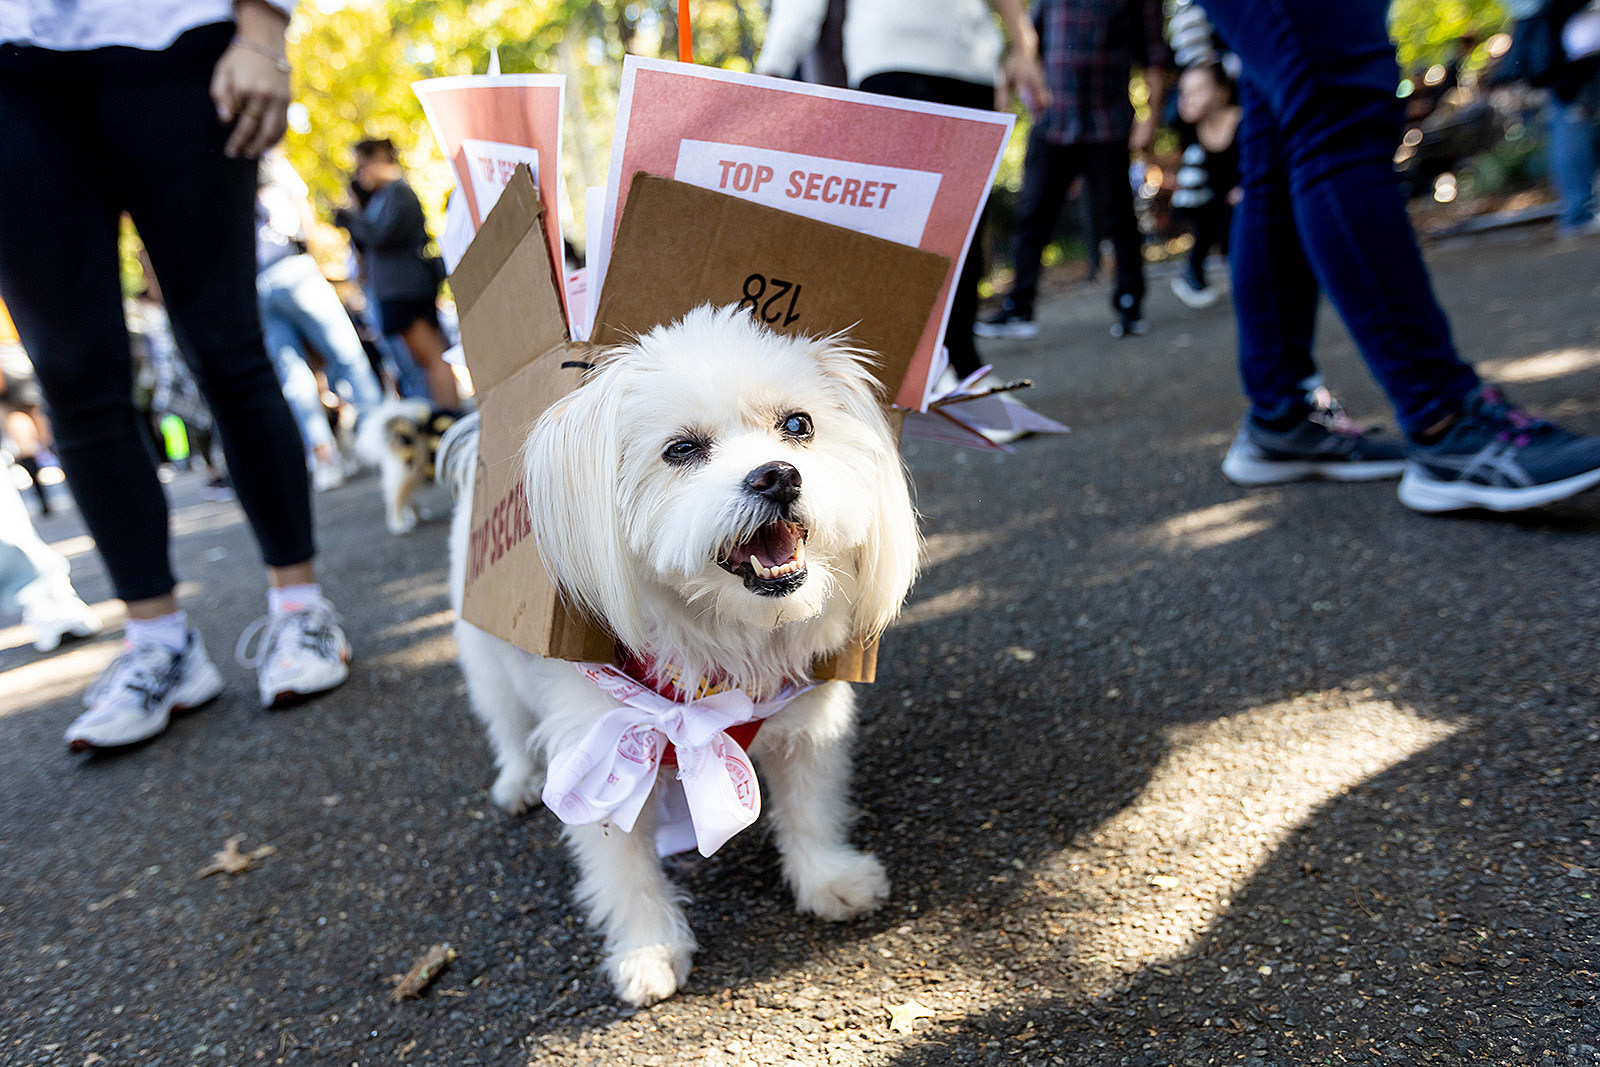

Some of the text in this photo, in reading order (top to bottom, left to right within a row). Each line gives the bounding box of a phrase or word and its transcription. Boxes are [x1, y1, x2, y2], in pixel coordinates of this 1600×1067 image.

[718, 160, 897, 209] TOP SECRET
[738, 273, 802, 327] 128
